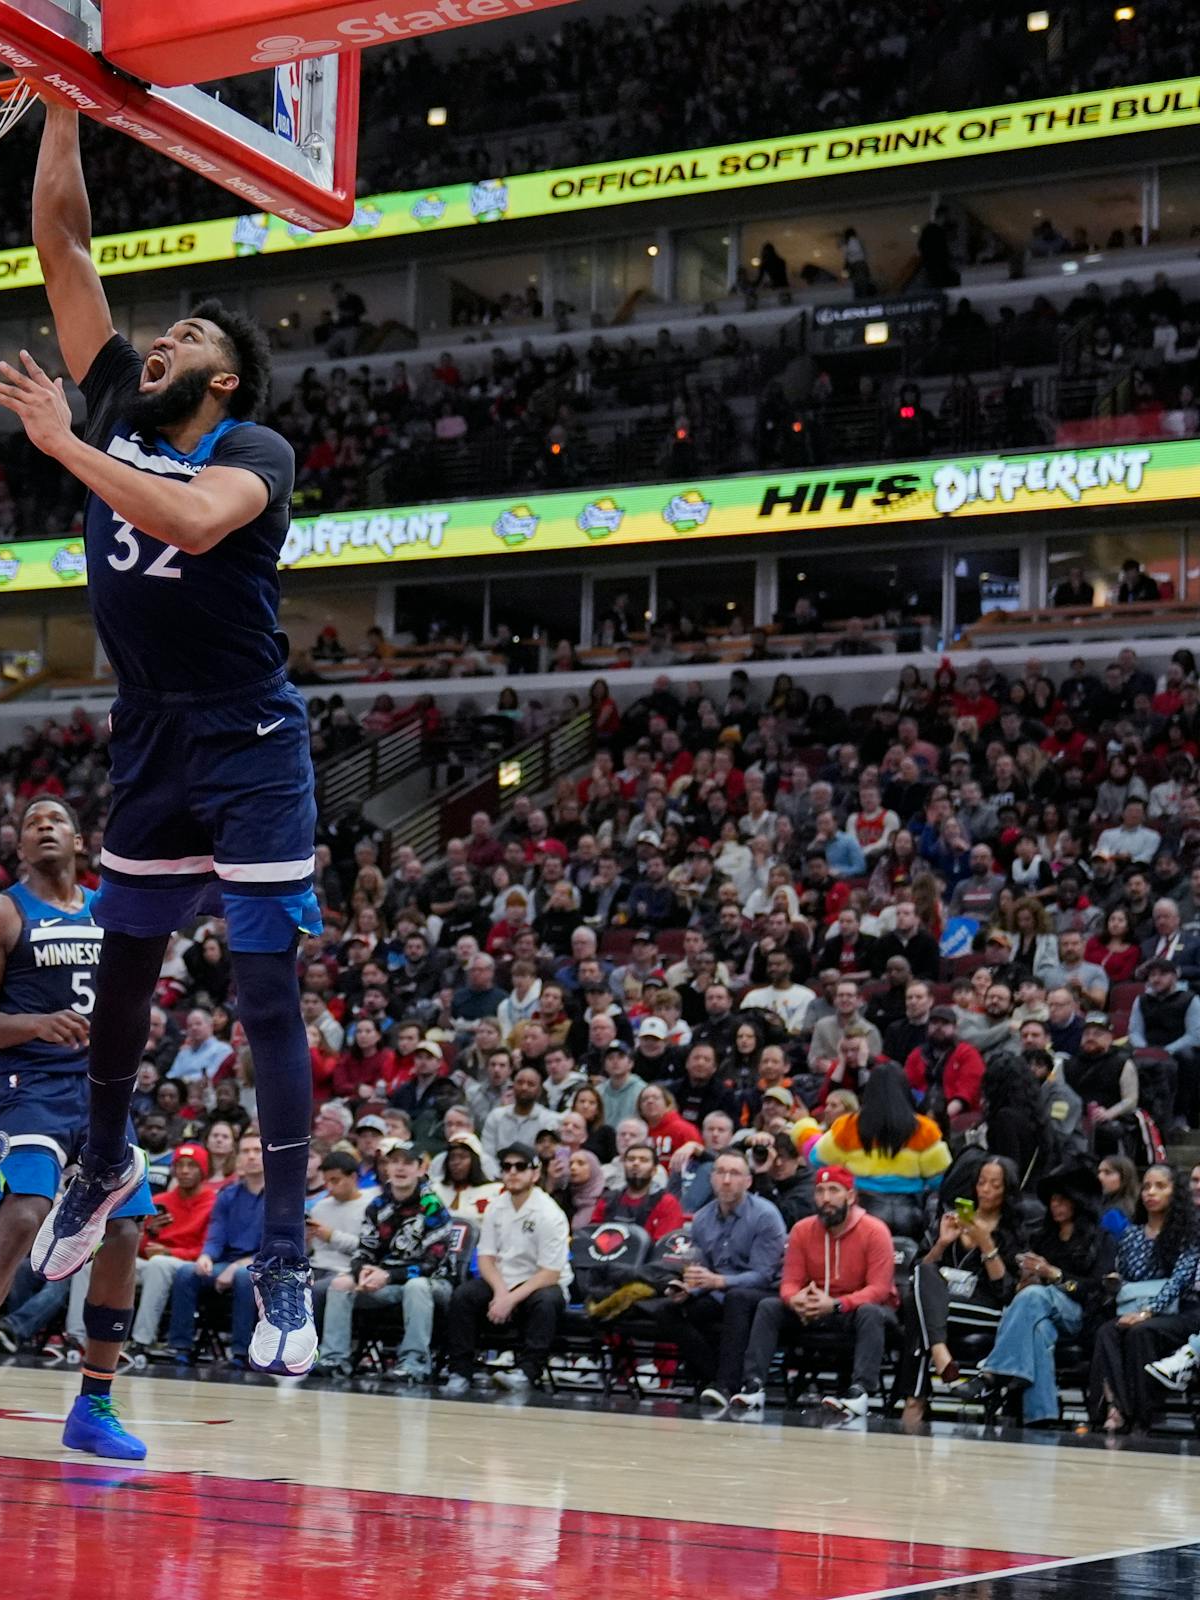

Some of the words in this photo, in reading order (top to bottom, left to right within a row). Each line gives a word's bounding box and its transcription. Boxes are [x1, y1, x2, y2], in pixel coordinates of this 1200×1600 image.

[43, 73, 102, 110] betway
[106, 115, 163, 141] betway
[167, 145, 221, 173] betway
[225, 177, 276, 203] betway
[277, 112, 290, 137] NBA
[551, 161, 708, 199] OFFICIAL
[719, 144, 818, 176] SOFT
[827, 125, 947, 160] DRINK
[958, 116, 1012, 142] OF
[1022, 104, 1103, 133] THE
[1112, 87, 1200, 120] BUL
[100, 233, 196, 264] BULLS
[758, 474, 921, 516] HITS
[933, 449, 1151, 514] DIFFERENT
[33, 943, 102, 968] MINNESO
[70, 971, 96, 1015] 5
[111, 1322, 124, 1331] 5
